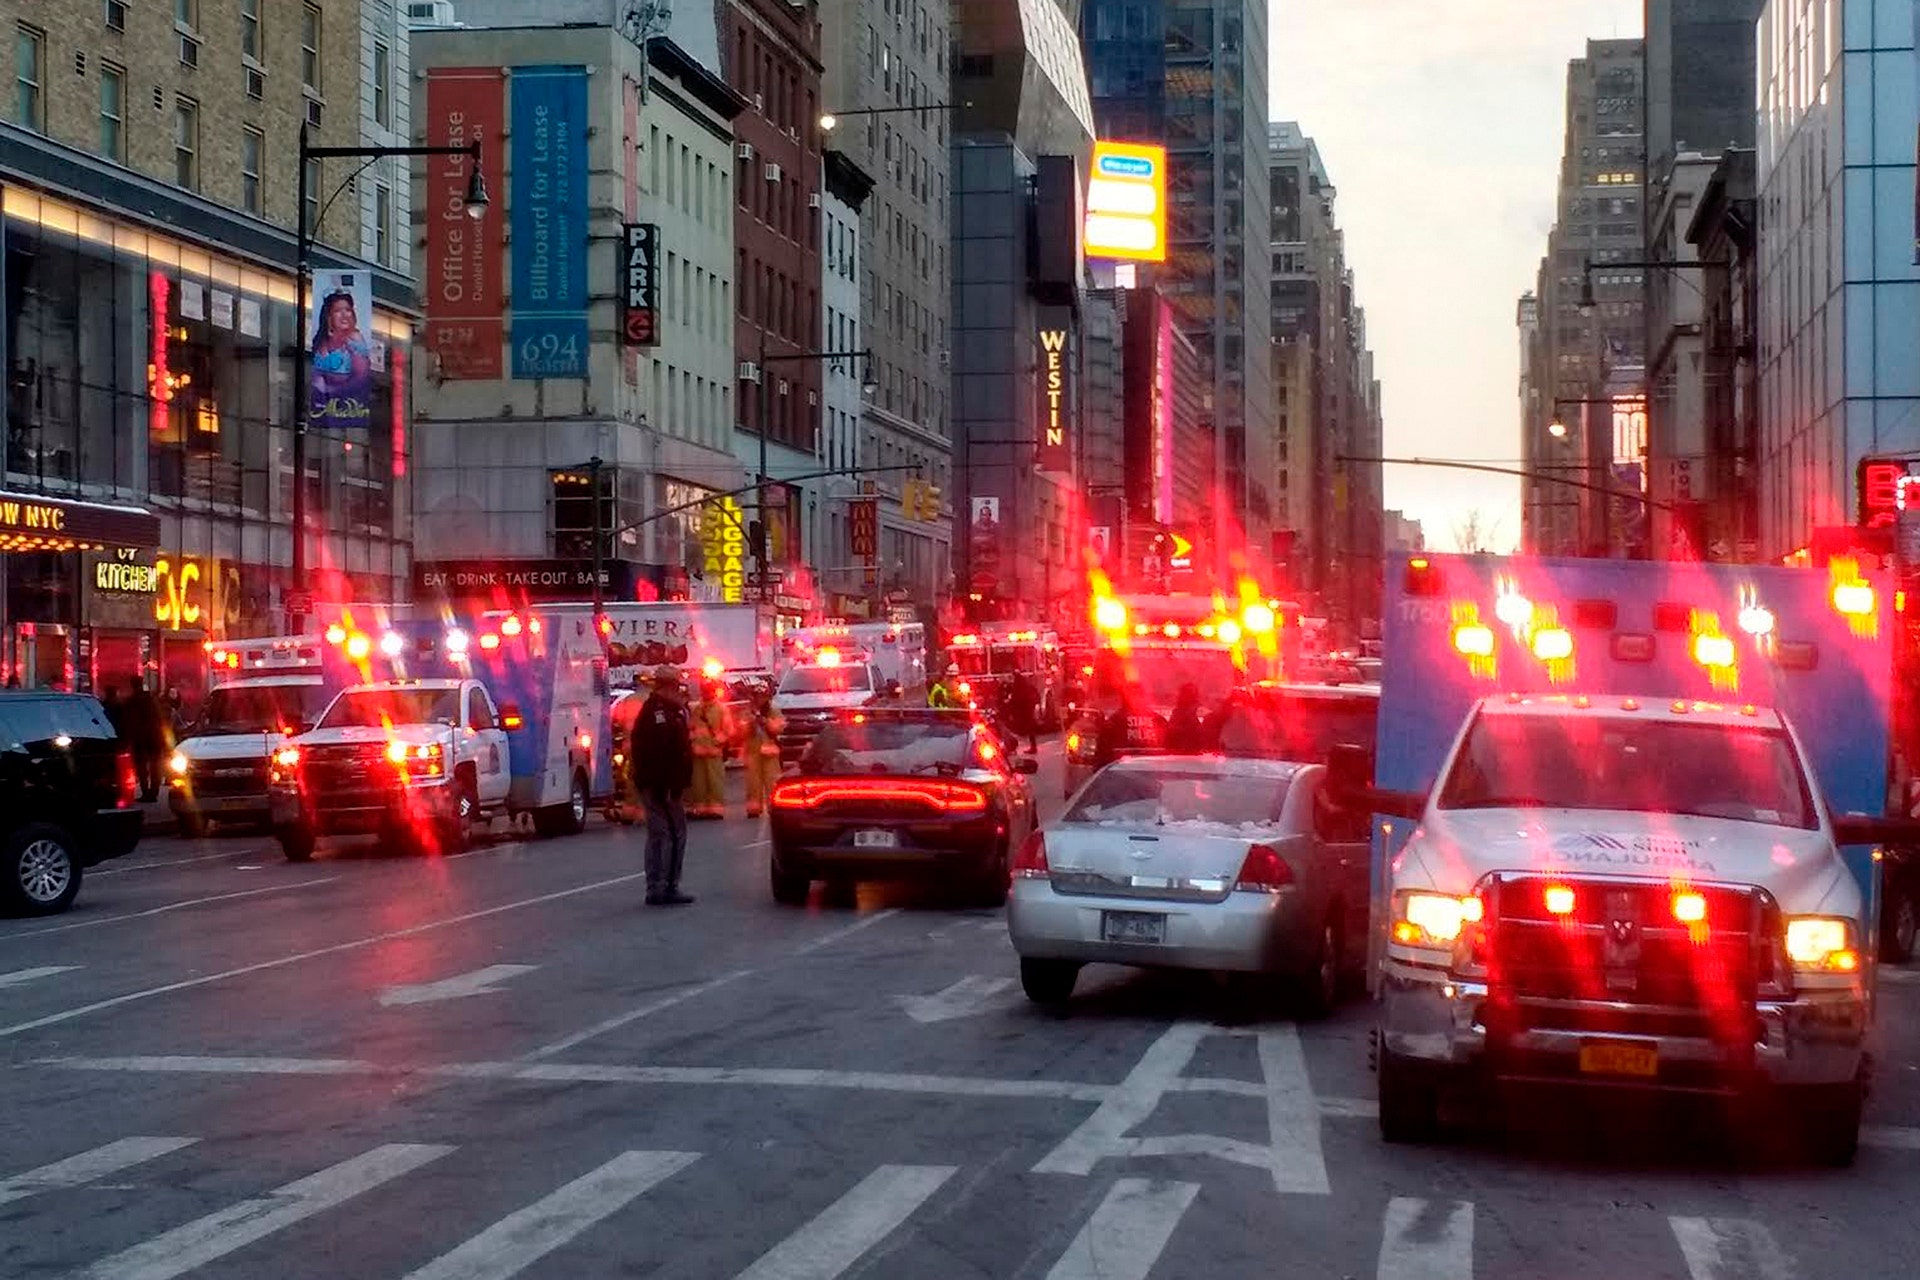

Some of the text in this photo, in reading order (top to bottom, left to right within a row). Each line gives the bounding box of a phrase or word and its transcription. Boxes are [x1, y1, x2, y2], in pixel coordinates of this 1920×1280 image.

[443, 111, 463, 302] Office for Lease
[531, 105, 549, 300] Billboard for Lease
[629, 228, 648, 307] PARK
[522, 334, 579, 361] 694
[1040, 331, 1066, 446] WESTIN
[26, 505, 65, 531] NYC
[723, 496, 743, 603] LUGGAGE
[96, 562, 157, 592] KITCHEN
[424, 573, 447, 586] EAT
